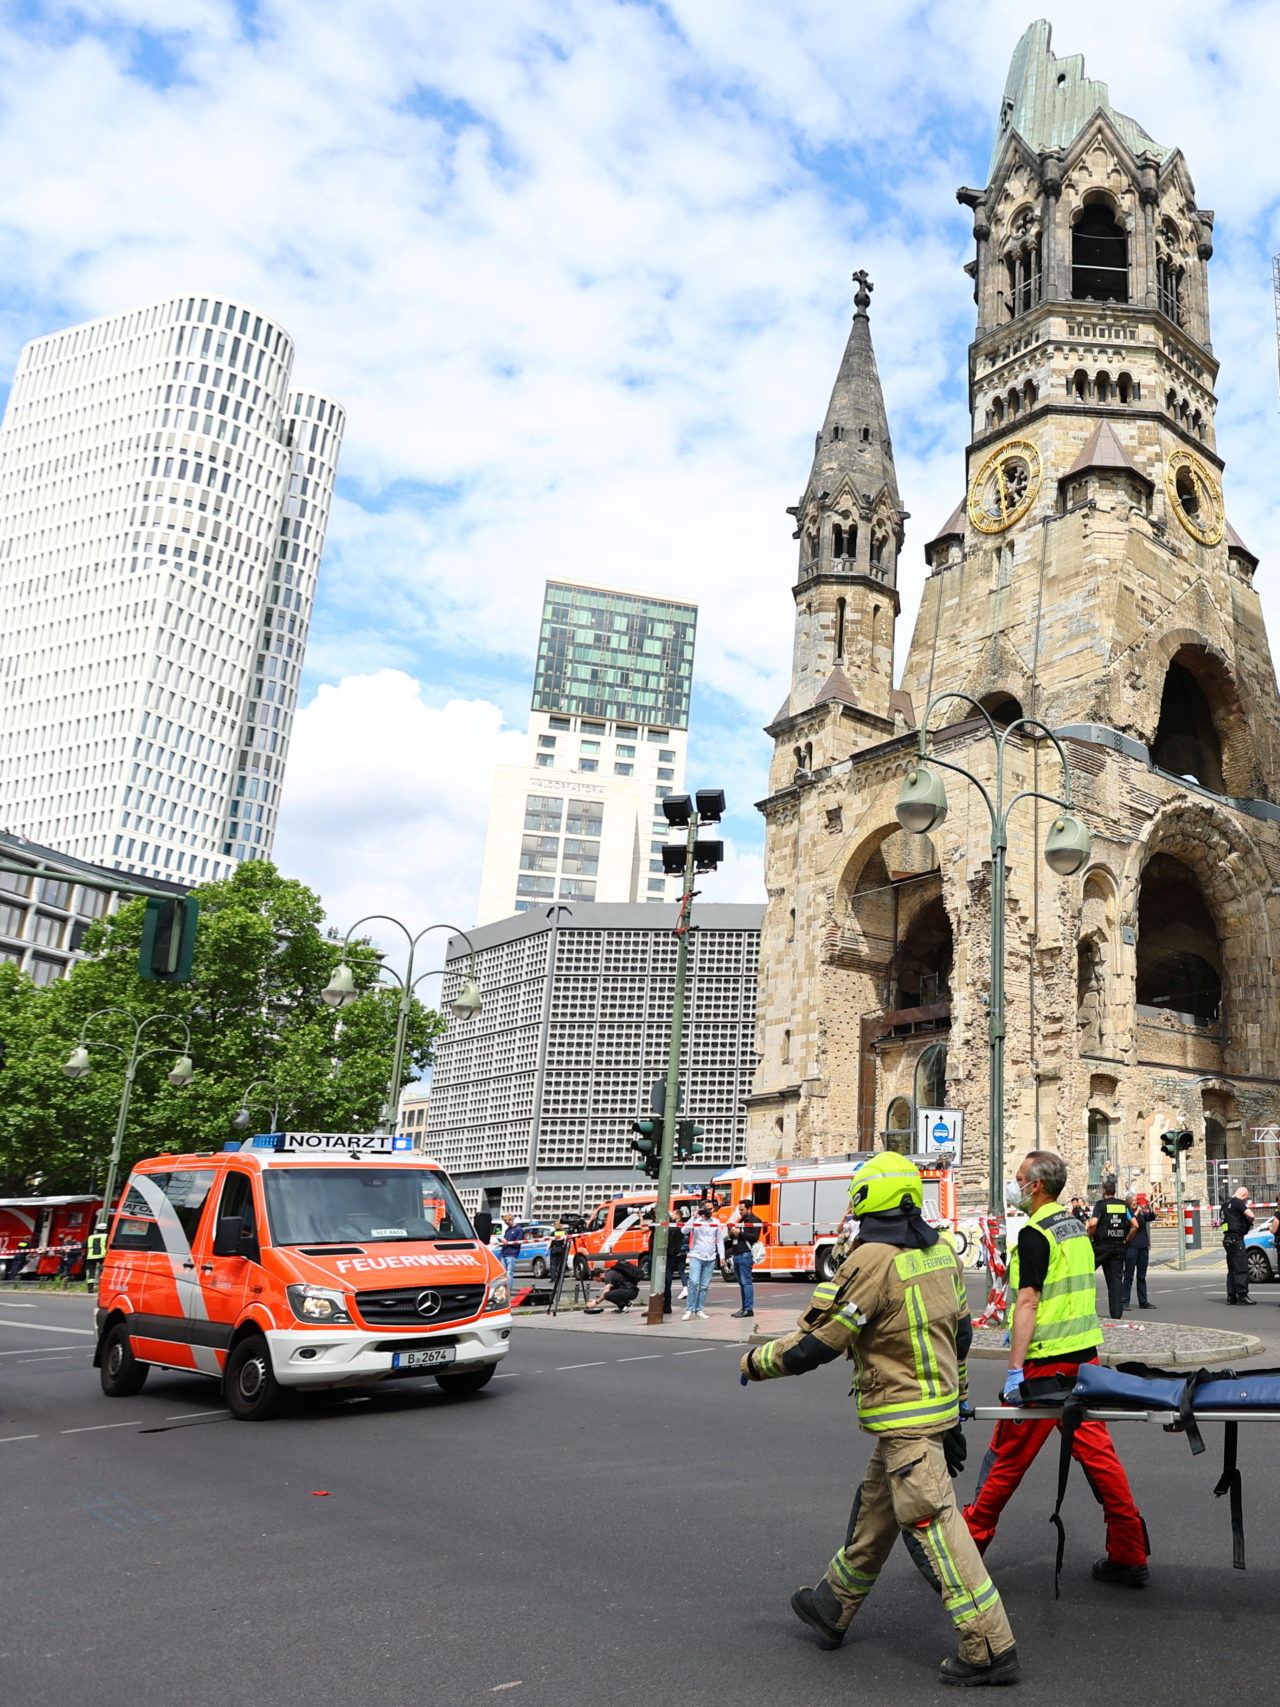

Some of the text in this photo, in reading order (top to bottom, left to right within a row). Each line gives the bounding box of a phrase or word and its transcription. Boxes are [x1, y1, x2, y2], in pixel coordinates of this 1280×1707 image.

[289, 1135, 389, 1149] NOTARZT
[336, 1254, 482, 1274] FEUERWEHR
[794, 1254, 815, 1269] 112
[407, 1350, 447, 1364] B 2674
